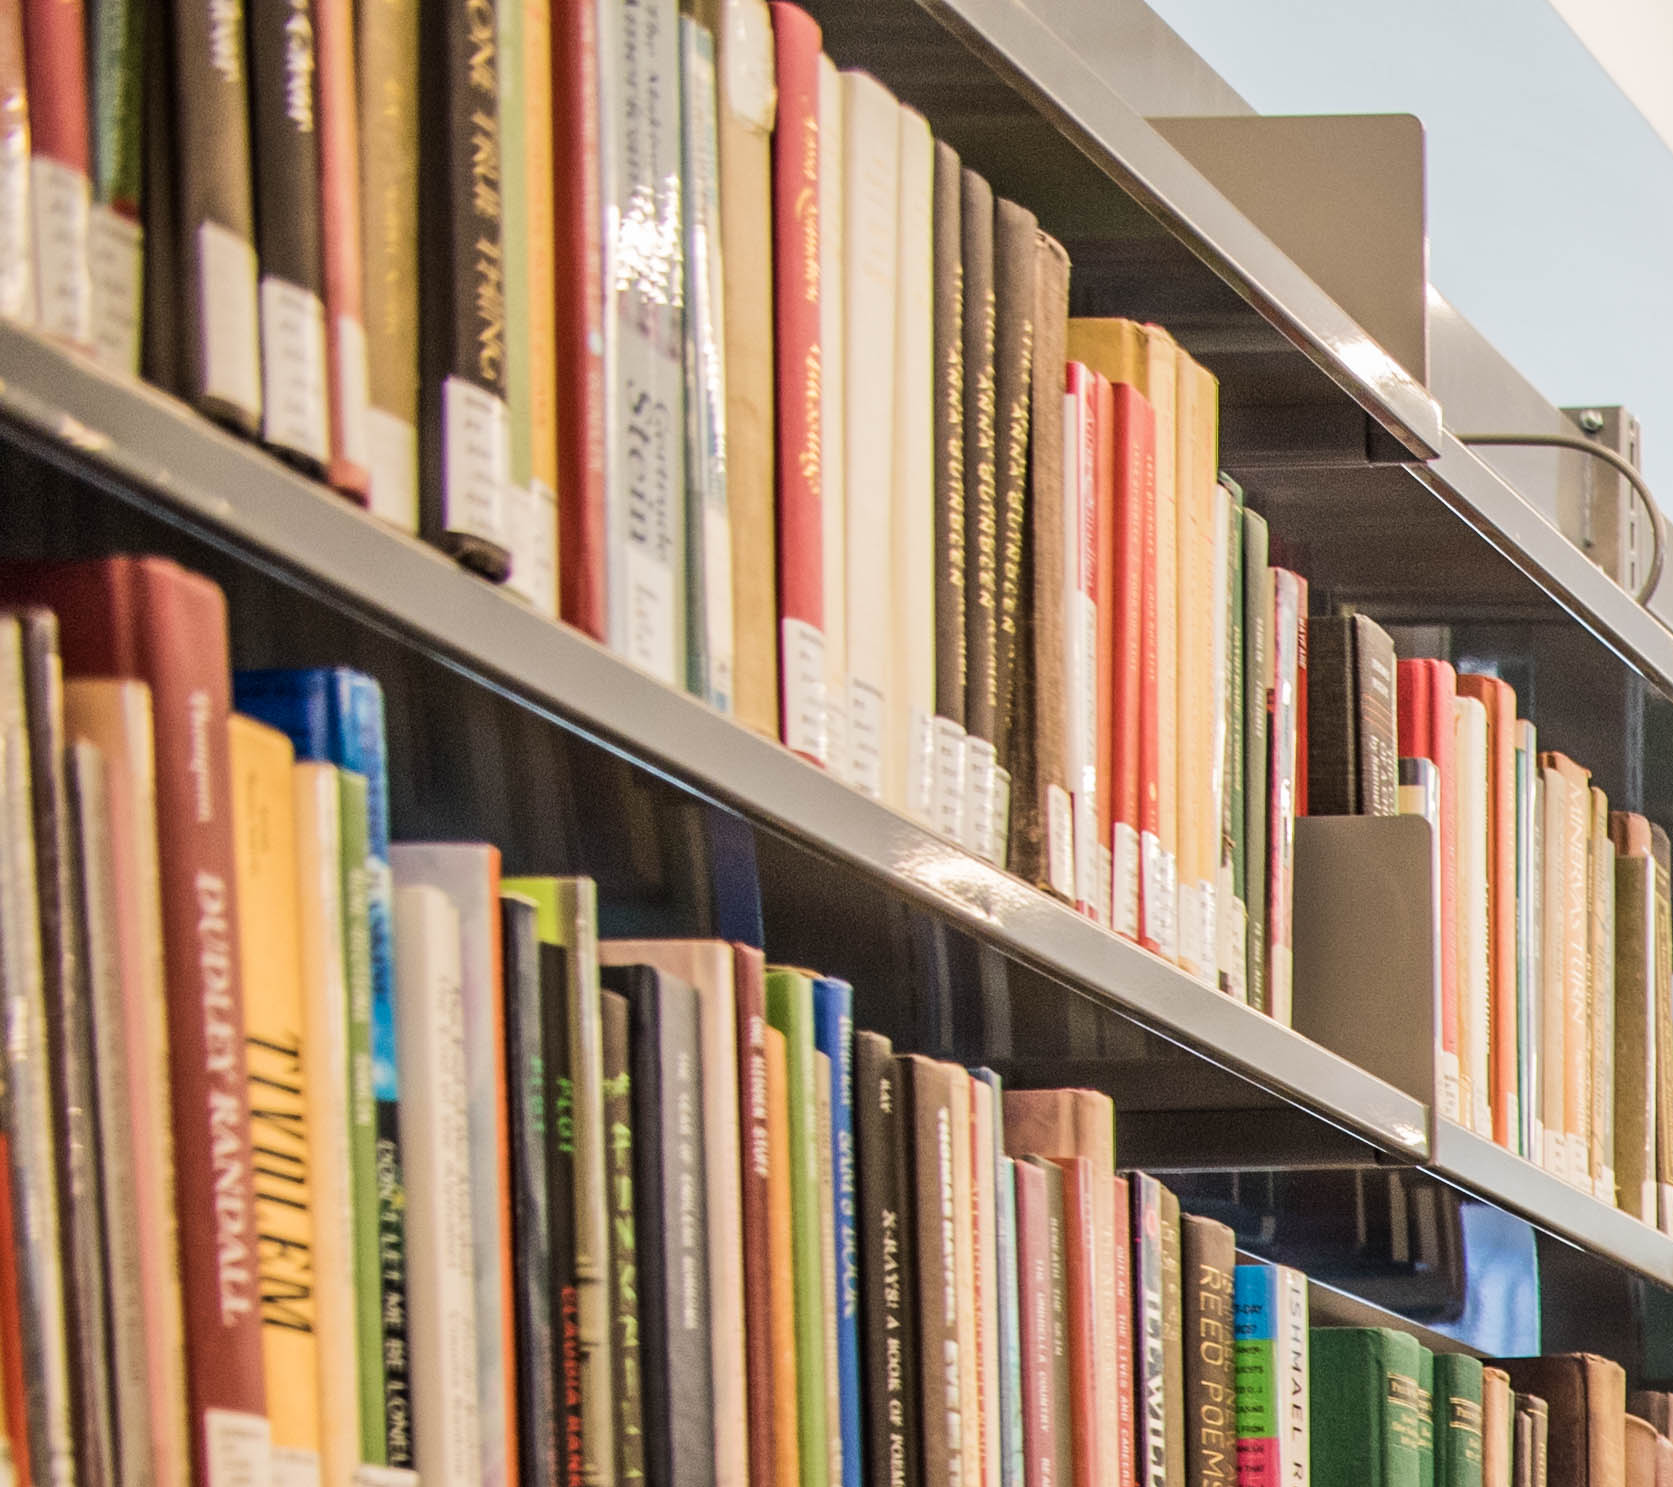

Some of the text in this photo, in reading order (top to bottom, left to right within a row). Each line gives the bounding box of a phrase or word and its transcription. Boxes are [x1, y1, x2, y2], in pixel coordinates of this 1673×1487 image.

[196, 874, 252, 1326] DUDLEY RANDALL
[1144, 1291, 1165, 1362] ILL
[1199, 1265, 1222, 1362] REED
[1289, 1286, 1305, 1442] ISHMAEL
